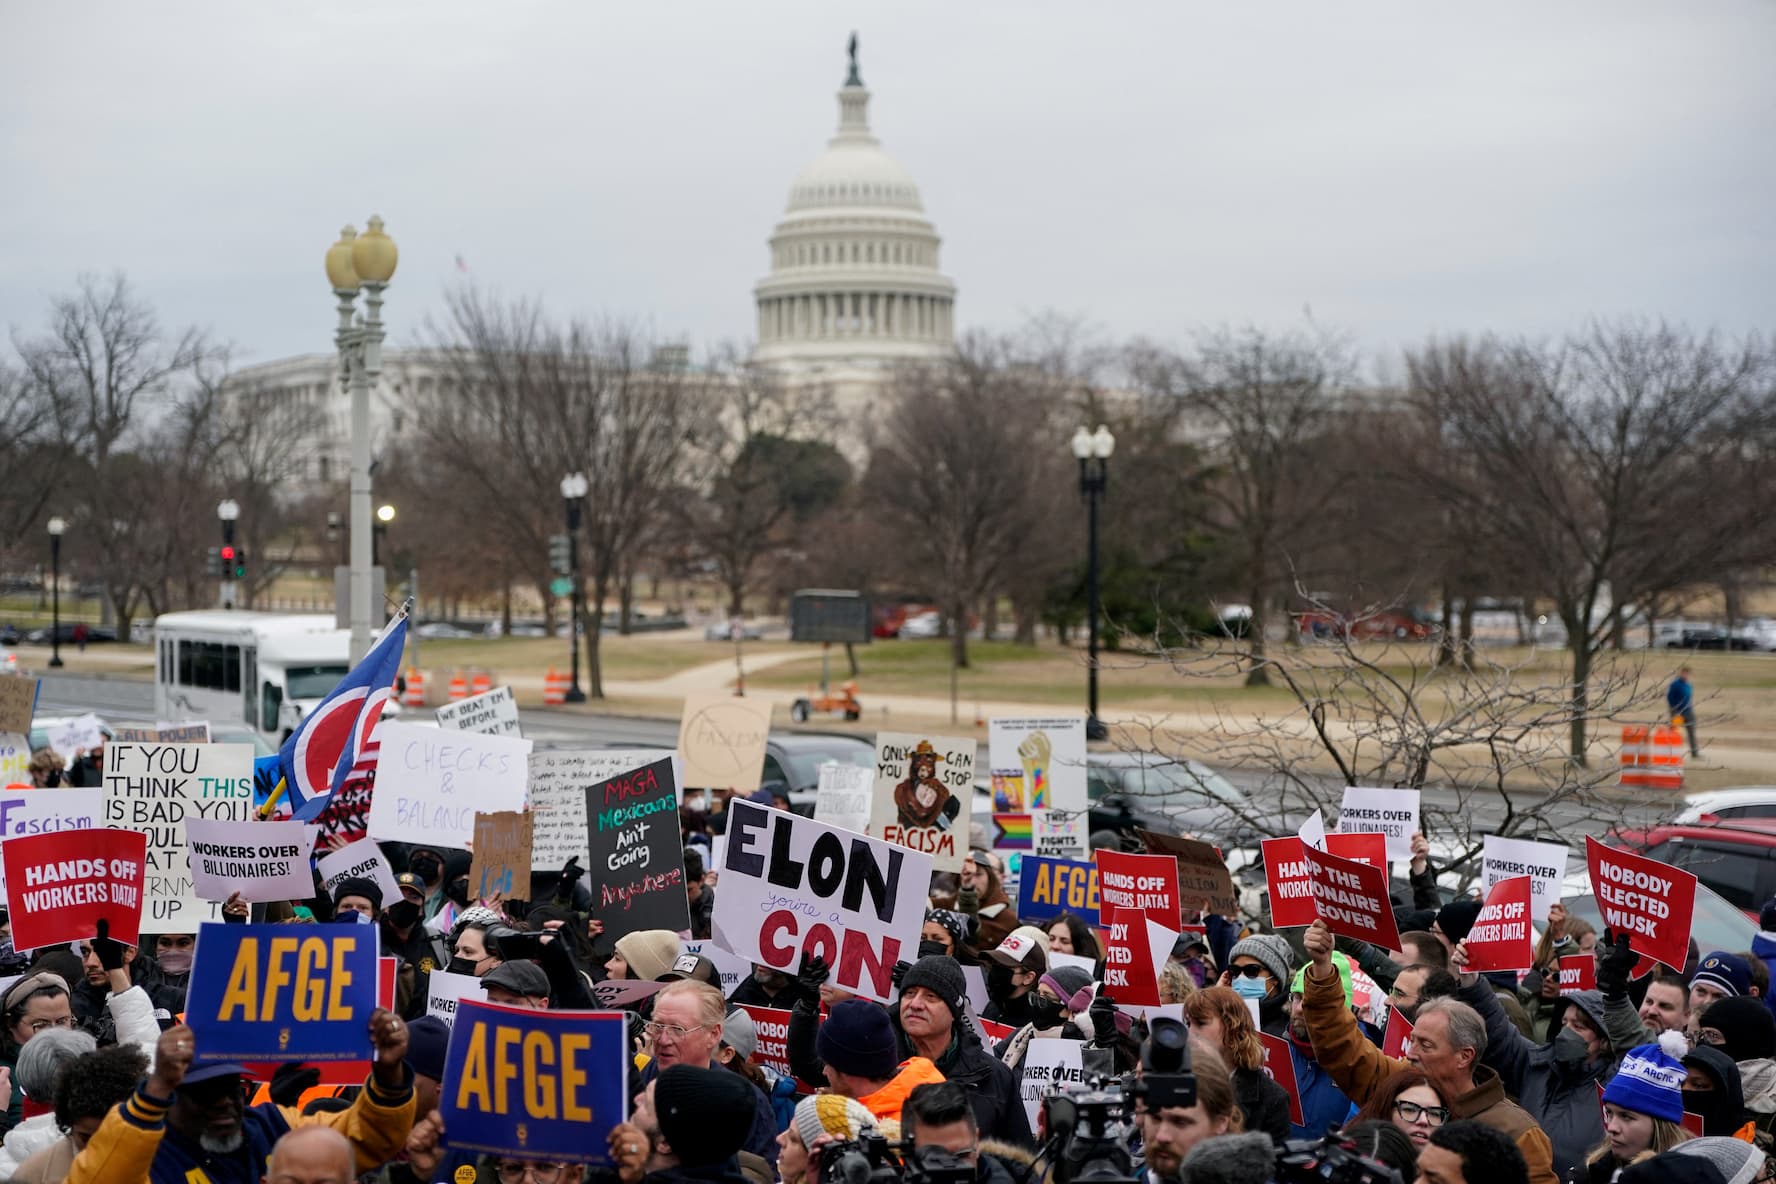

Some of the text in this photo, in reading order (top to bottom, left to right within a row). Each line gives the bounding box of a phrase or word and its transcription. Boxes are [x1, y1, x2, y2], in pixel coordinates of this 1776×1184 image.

[111, 746, 199, 774] IF YOU
[404, 741, 511, 774] CHECKS
[882, 745, 973, 766] ONLY CAN
[440, 772, 457, 796] &
[878, 763, 972, 785] YOU STOP
[106, 776, 251, 798] THINK THIS
[605, 768, 658, 804] MAGA
[0, 799, 92, 836] Fascism
[106, 800, 247, 823] IS BAD YOU
[598, 794, 676, 832] Mexicans
[1383, 810, 1412, 822] OVER
[616, 822, 650, 850] Ain't
[884, 825, 955, 856] FACISM
[1040, 836, 1077, 846] FIGHTS
[192, 841, 299, 858] WORKERS OVER
[607, 845, 650, 871] Going
[25, 859, 137, 887] HANDS OFF
[203, 861, 290, 878] BILLIONAIRES!
[351, 857, 379, 875] OVER
[725, 802, 905, 924] ELON
[1278, 862, 1309, 878] HAN
[1527, 864, 1556, 879] OVER
[601, 868, 681, 911] Anywhere
[1103, 871, 1165, 891] HANDS OFF
[1277, 879, 1313, 899] WORK
[1324, 866, 1362, 890] THE
[1599, 859, 1673, 898] NOBODY
[23, 883, 108, 913] WORKERS
[111, 883, 137, 909] DATA!
[1103, 888, 1134, 908] WORKERS
[1137, 894, 1170, 909] DATA!
[1599, 881, 1669, 920] ELECTED
[153, 901, 182, 920] UP
[829, 911, 845, 926] a
[1475, 902, 1525, 923] ANDS OFF
[1502, 921, 1525, 940] DATA!
[1606, 908, 1656, 939] MUSK
[759, 909, 902, 999] CON
[217, 937, 356, 1022] AFGE
[719, 973, 740, 984] ORK
[1104, 969, 1129, 986] USK
[756, 1039, 787, 1059] ELECT
[456, 1021, 592, 1122] AFGE
